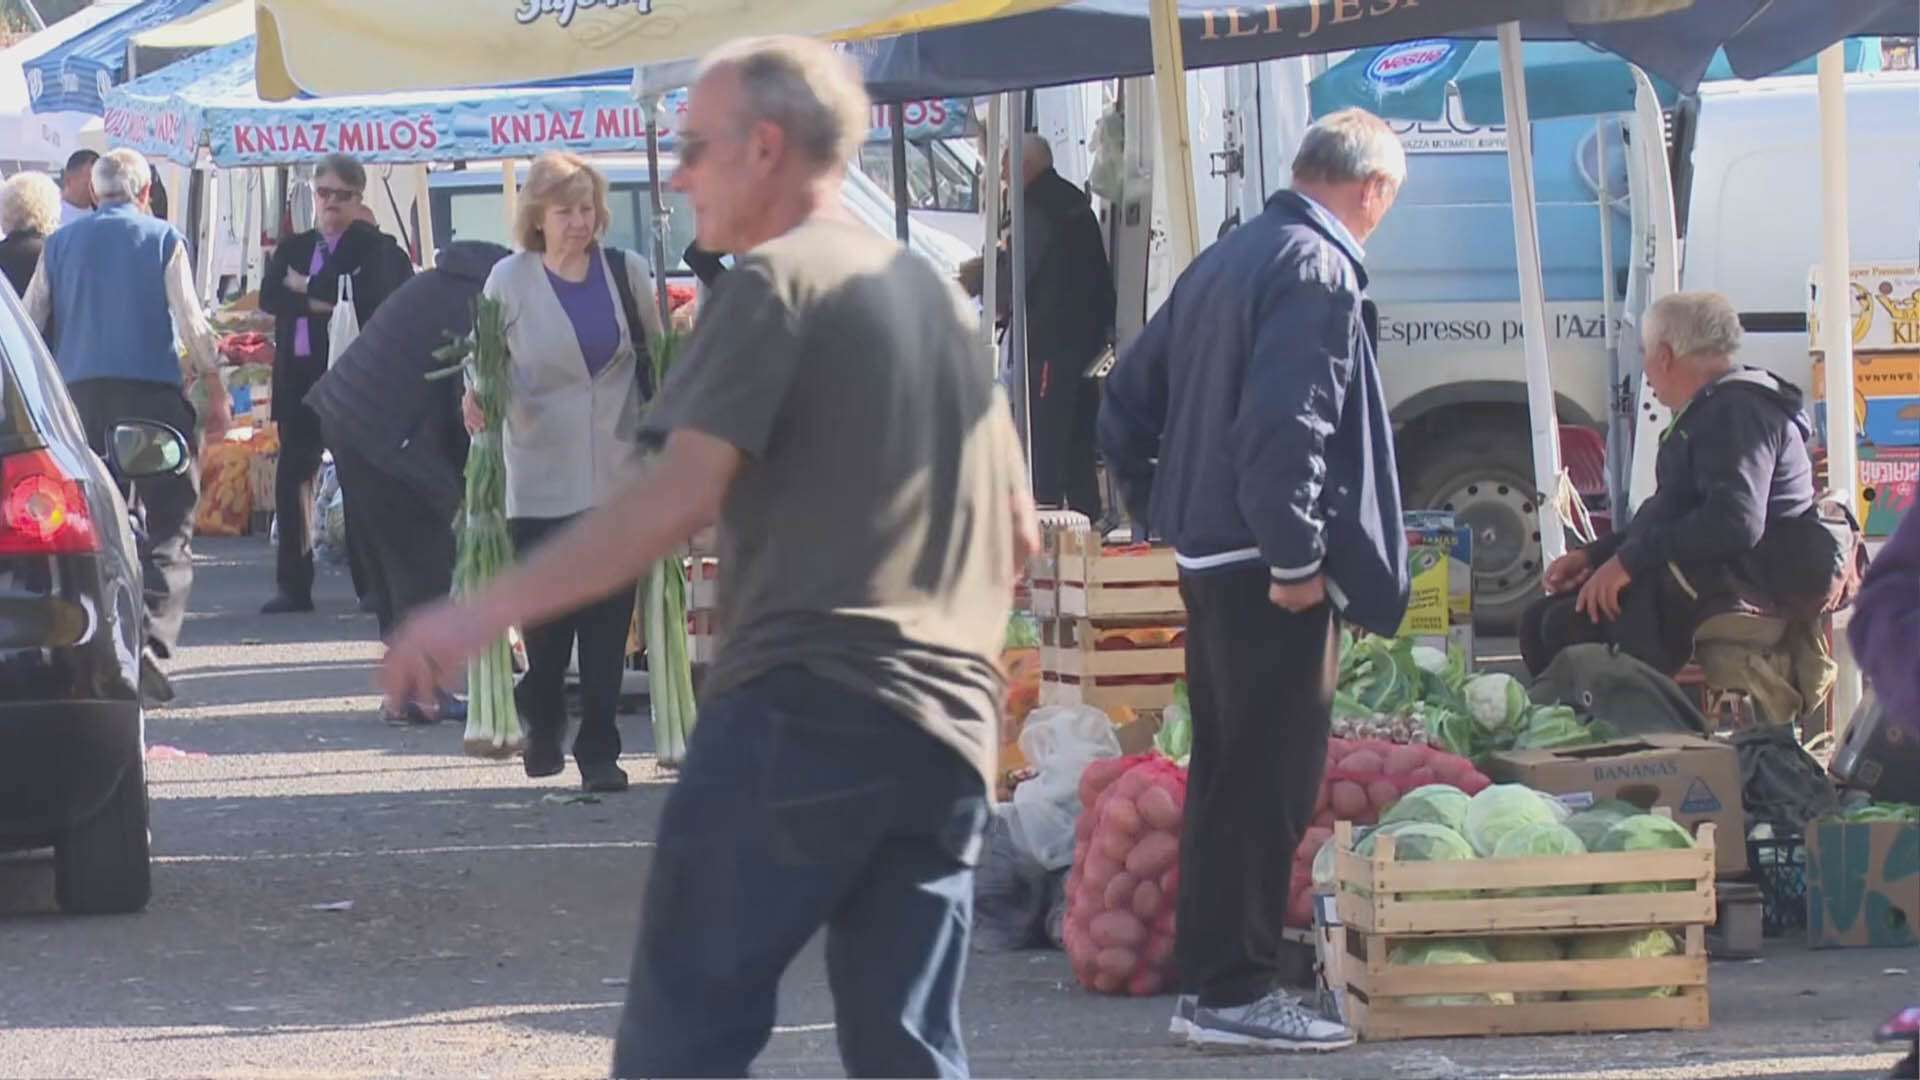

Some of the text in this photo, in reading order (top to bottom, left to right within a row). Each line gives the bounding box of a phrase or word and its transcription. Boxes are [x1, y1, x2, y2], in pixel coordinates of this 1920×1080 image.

[1200, 0, 1419, 40] ILI JES
[1377, 48, 1446, 72] Nestlé
[234, 123, 328, 153] KNJAZ
[338, 113, 437, 153] MILOŠ
[490, 102, 688, 145] KNJAZ MIL
[1377, 314, 1491, 346] Espresso
[1857, 373, 1913, 383] BANANAS
[1593, 760, 1680, 782] BANANAS
